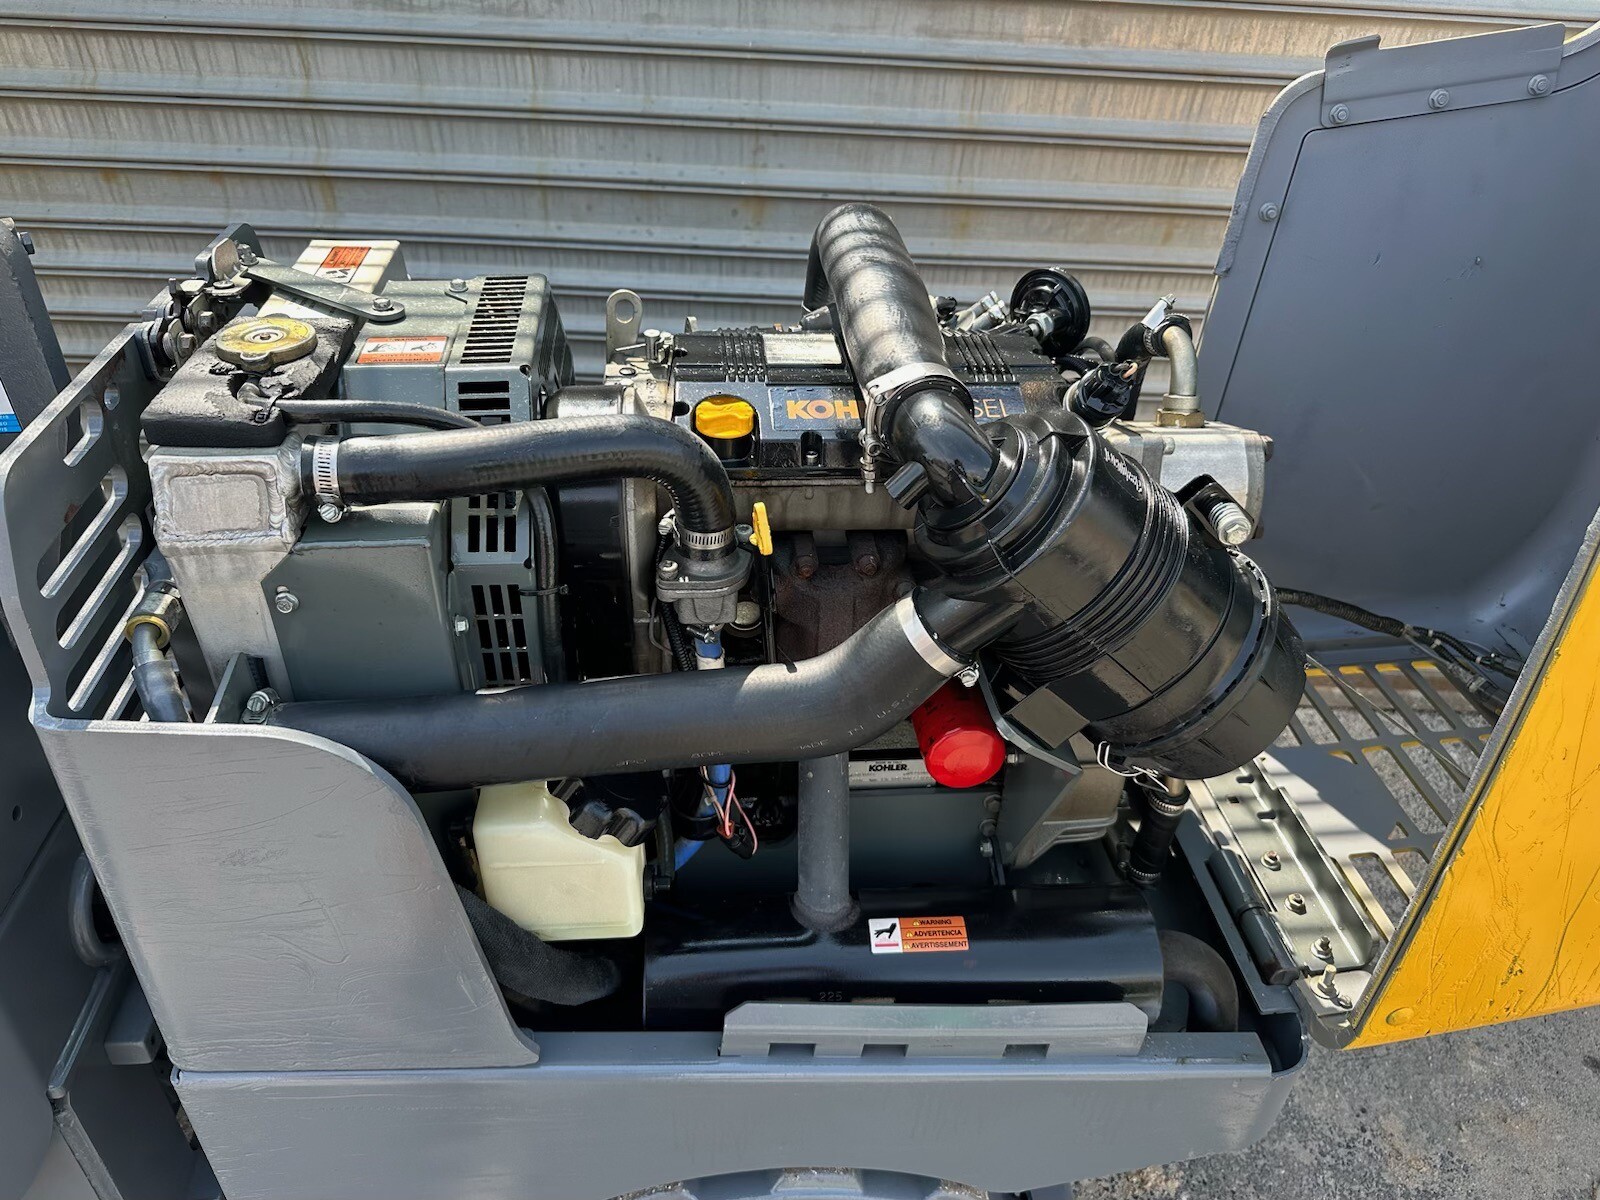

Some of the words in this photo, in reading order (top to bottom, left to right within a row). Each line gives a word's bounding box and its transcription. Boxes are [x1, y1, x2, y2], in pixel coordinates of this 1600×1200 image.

[786, 399, 859, 420] KOH
[868, 763, 908, 772] KOHLER
[914, 929, 962, 938] ADVERTENCIA
[911, 940, 968, 949] AVERTISSEMENT
